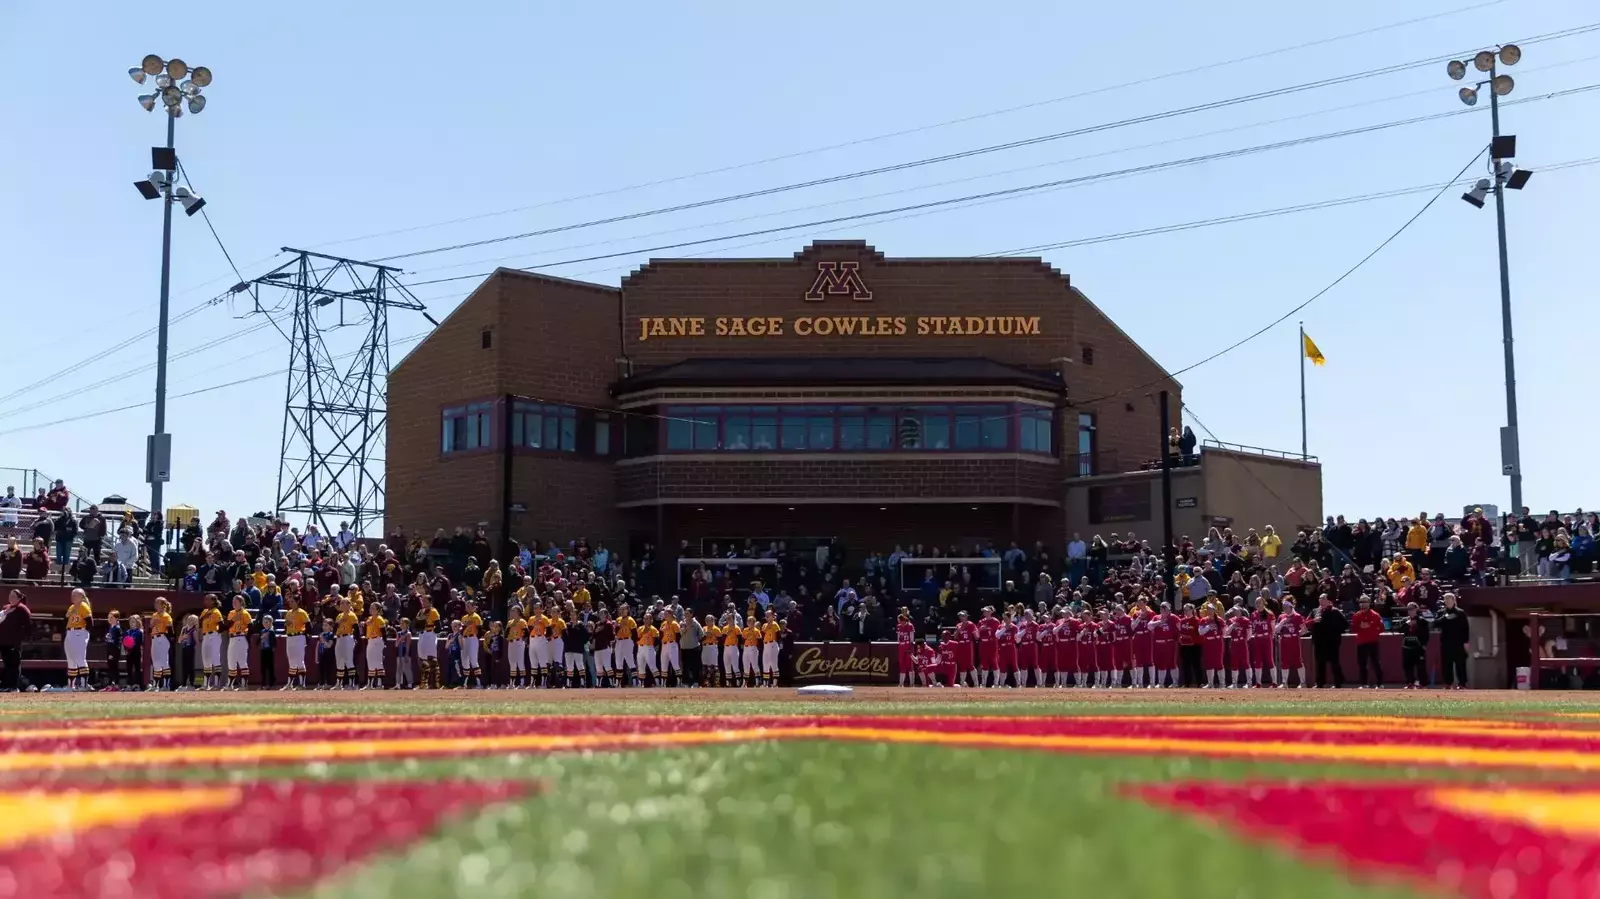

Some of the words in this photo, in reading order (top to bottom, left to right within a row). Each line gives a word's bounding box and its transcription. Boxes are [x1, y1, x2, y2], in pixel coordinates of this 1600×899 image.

[805, 261, 873, 300] M
[639, 317, 705, 341] JANE
[715, 317, 784, 336] SAGE
[793, 316, 907, 336] COWLES
[917, 316, 1041, 335] STADIUM
[795, 646, 889, 677] Gophers
